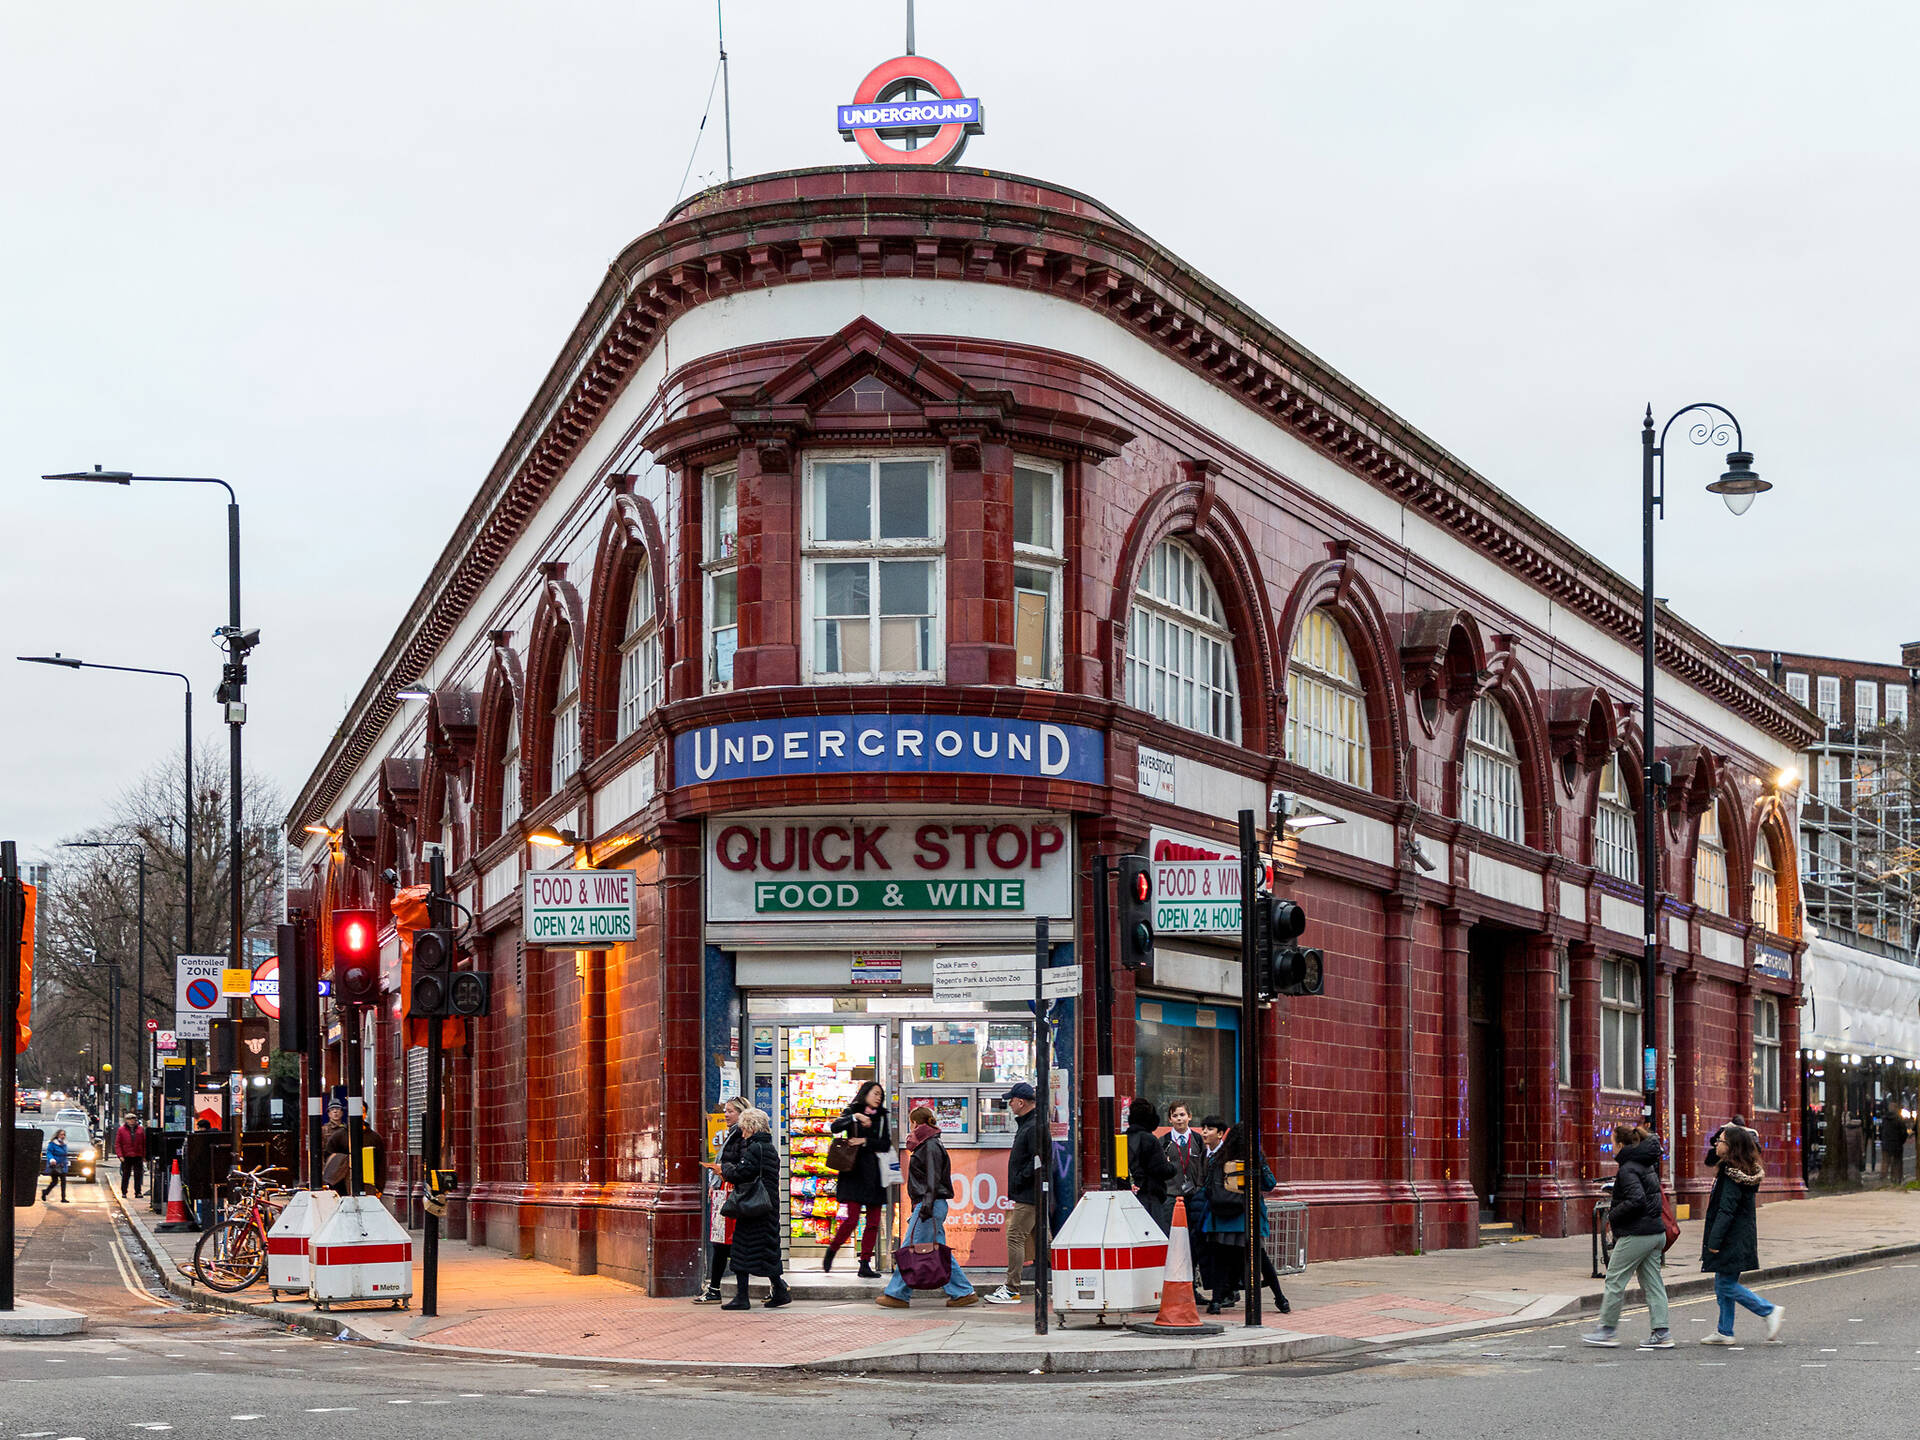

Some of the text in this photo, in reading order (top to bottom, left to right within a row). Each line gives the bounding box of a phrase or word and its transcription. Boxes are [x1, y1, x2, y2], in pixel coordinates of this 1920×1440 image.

[843, 103, 973, 125] UNDERGROUND
[694, 723, 1071, 780] UNDERGROUND
[1138, 752, 1174, 776] AVERSTOCK
[1138, 771, 1151, 787] ILL
[715, 823, 1065, 872] QUICK STOP
[533, 877, 630, 905] FOOD & WINE
[1158, 868, 1242, 897] FOOD & WIN
[757, 883, 1022, 909] FOOD & WINE
[533, 914, 631, 937] OPEN 24 HOURS
[1157, 907, 1189, 929] OPEN
[1193, 907, 1208, 928] 24
[181, 958, 225, 966] Controlled
[187, 967, 219, 976] ZONE
[936, 976, 962, 985] Regent's
[1008, 974, 1021, 982] Zoo
[963, 991, 972, 999] Hill
[963, 1212, 1005, 1225] £13.50
